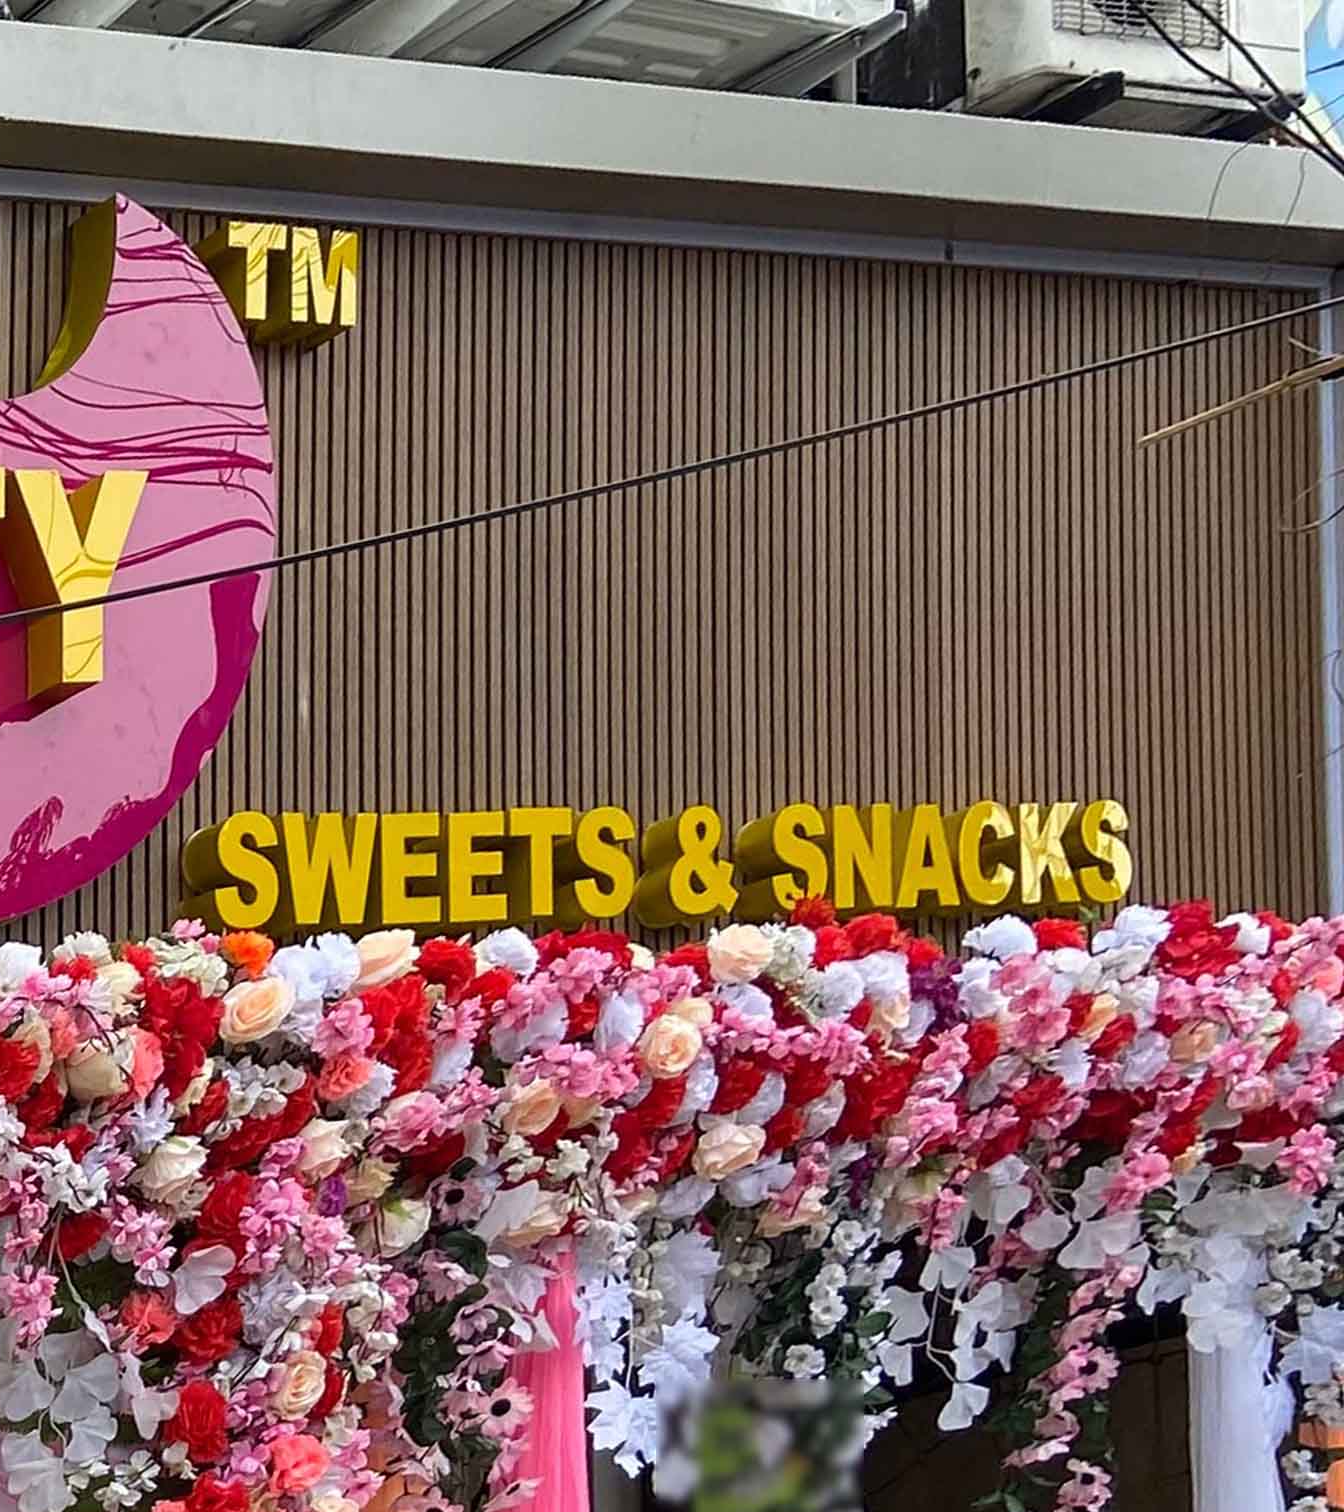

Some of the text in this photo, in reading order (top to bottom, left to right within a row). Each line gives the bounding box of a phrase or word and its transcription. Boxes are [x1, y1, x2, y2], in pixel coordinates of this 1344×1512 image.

[227, 220, 359, 328] TM
[214, 798, 1135, 931] SWEETS & SNACKS
